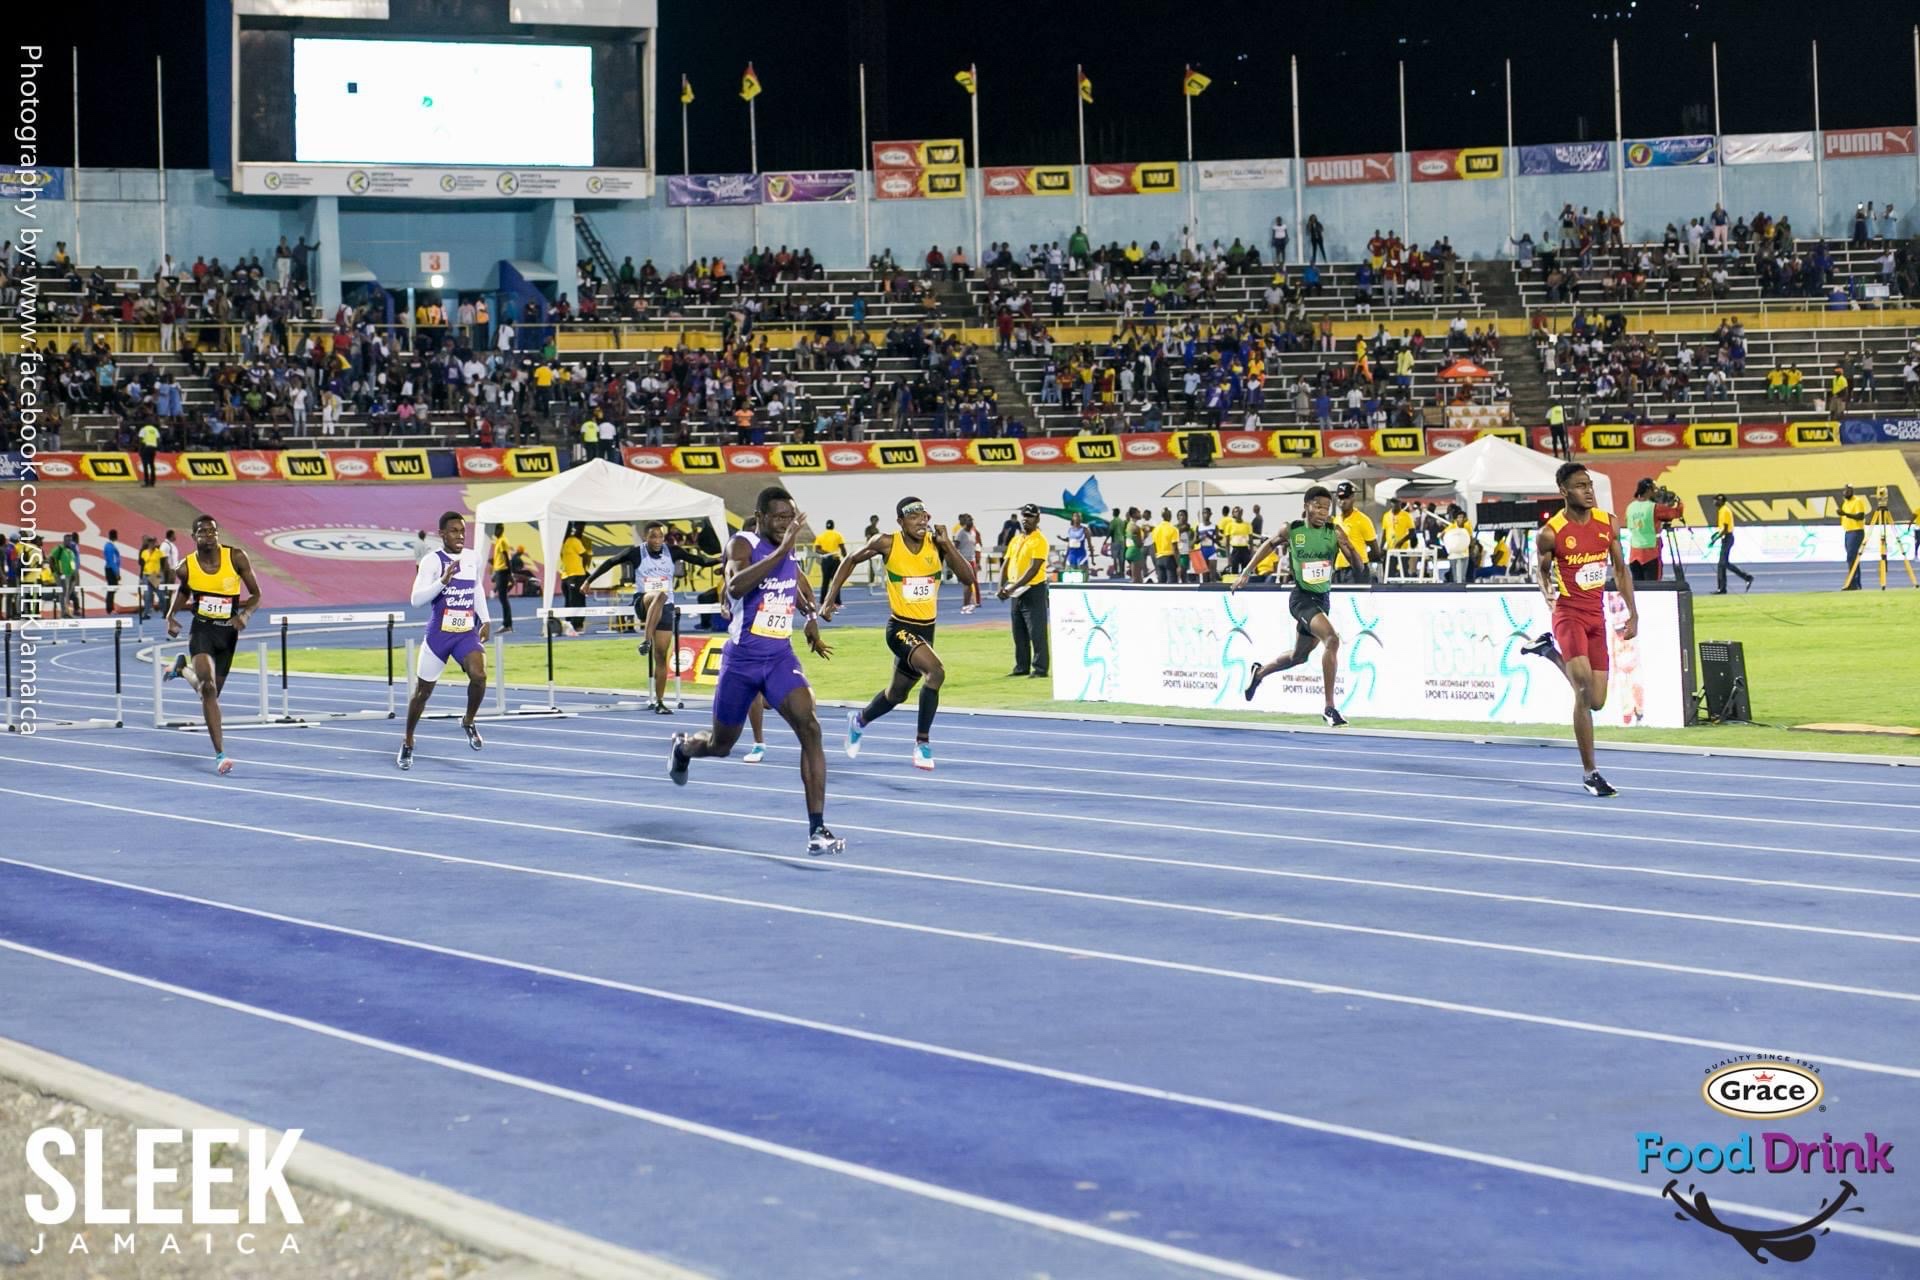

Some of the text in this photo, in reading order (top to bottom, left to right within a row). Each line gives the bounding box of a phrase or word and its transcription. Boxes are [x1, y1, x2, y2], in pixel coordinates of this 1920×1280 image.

[1826, 132, 1883, 154] PUMA
[1307, 159, 1364, 182] PUMA
[429, 254, 441, 271] 3
[1646, 434, 1672, 444] Grace
[1749, 432, 1774, 442] Grace
[1130, 443, 1157, 453] Grace
[1231, 440, 1257, 450] Grace
[1333, 440, 1359, 449] Grace
[833, 453, 860, 463] Grace
[931, 450, 958, 459] Grace
[1030, 448, 1057, 458] Grace
[468, 460, 494, 469] Grace
[635, 456, 660, 466] Grace
[735, 455, 761, 465] Grace
[43, 462, 73, 473] Grace
[241, 463, 269, 472] Grace
[338, 462, 364, 471] Grace
[1311, 569, 1324, 578] 151
[913, 585, 929, 596] 435
[207, 604, 223, 613] 511
[767, 614, 787, 629] 873
[1425, 689, 1495, 701] SPORTS ASSOCIATION
